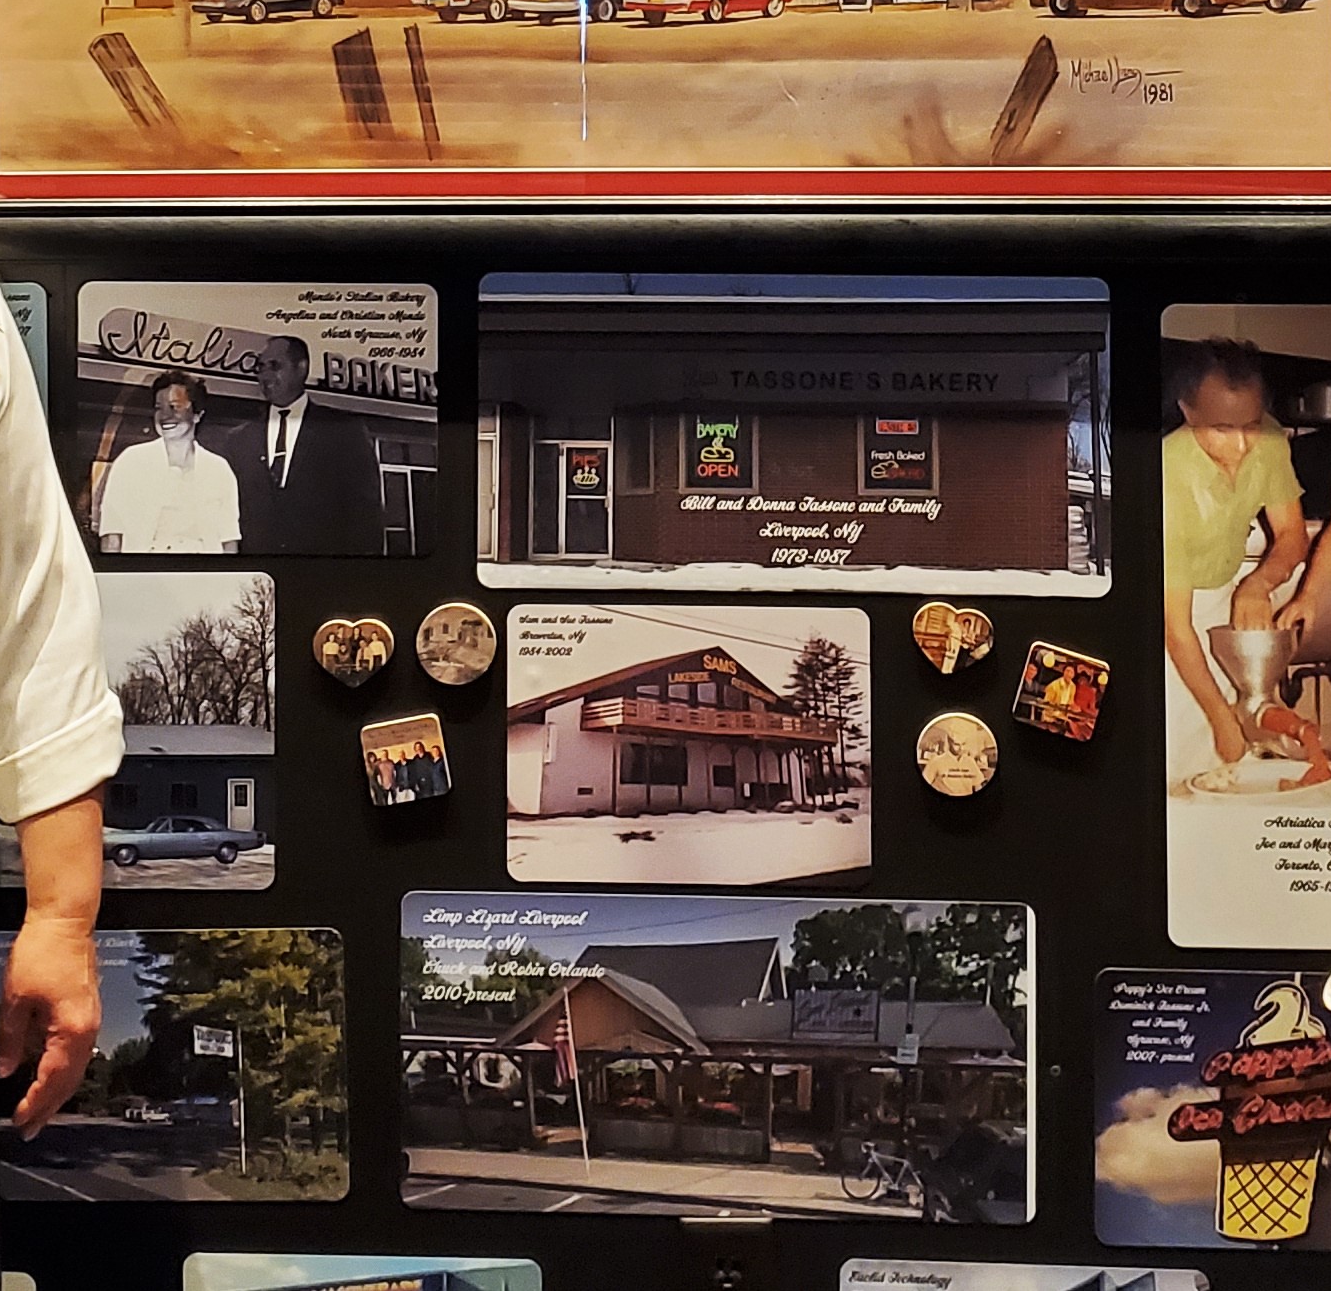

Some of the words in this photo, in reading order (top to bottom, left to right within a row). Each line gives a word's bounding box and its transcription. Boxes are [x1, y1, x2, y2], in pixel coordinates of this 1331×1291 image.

[1143, 83, 1173, 104] 1981
[345, 291, 383, 302] Italian
[386, 292, 426, 307] Bakery
[266, 310, 316, 323] Angelina
[319, 310, 338, 320] and
[340, 310, 386, 321] Christian
[108, 311, 261, 375] Italia
[321, 328, 352, 339] North
[405, 327, 428, 343] NY
[731, 370, 881, 392] TASSONE'S
[892, 370, 1000, 392] BAKERY
[697, 423, 739, 439] BAKERY
[871, 451, 894, 460] Fresh
[896, 450, 925, 460] Baked
[697, 463, 739, 478] OPEN
[680, 495, 715, 511] Bill
[717, 496, 744, 510] and
[746, 497, 795, 512] Donna
[799, 496, 856, 513] Tassone
[858, 498, 887, 513] and
[888, 497, 942, 520] Family
[759, 522, 830, 541] Liverpool,
[834, 520, 864, 543] NY
[771, 548, 852, 565] 1973-1987
[519, 615, 540, 624] Sam
[541, 615, 558, 624] and
[579, 615, 614, 625] Tassone
[568, 629, 587, 643] NY
[702, 654, 737, 675] SAMS
[1264, 816, 1325, 829] Adriatica
[1255, 838, 1276, 851] Joe
[1279, 838, 1301, 850] and
[1275, 860, 1323, 873] Toronto,
[423, 908, 463, 927] Limp
[465, 909, 518, 931] Lizard
[519, 910, 589, 928] Liverpool
[422, 934, 493, 952] Liverpool,
[496, 933, 527, 955] NY
[422, 960, 464, 975] Chuck
[468, 962, 496, 975] and
[498, 961, 545, 977] Robin
[548, 961, 605, 978] Orlando
[421, 985, 517, 1004] 2010-present
[1132, 1017, 1152, 1027] and
[1152, 1017, 1188, 1032] Family
[1173, 1033, 1195, 1049] NY
[1159, 1052, 1195, 1064] present
[849, 1270, 885, 1285] Euclid
[889, 1271, 952, 1289] Technology
